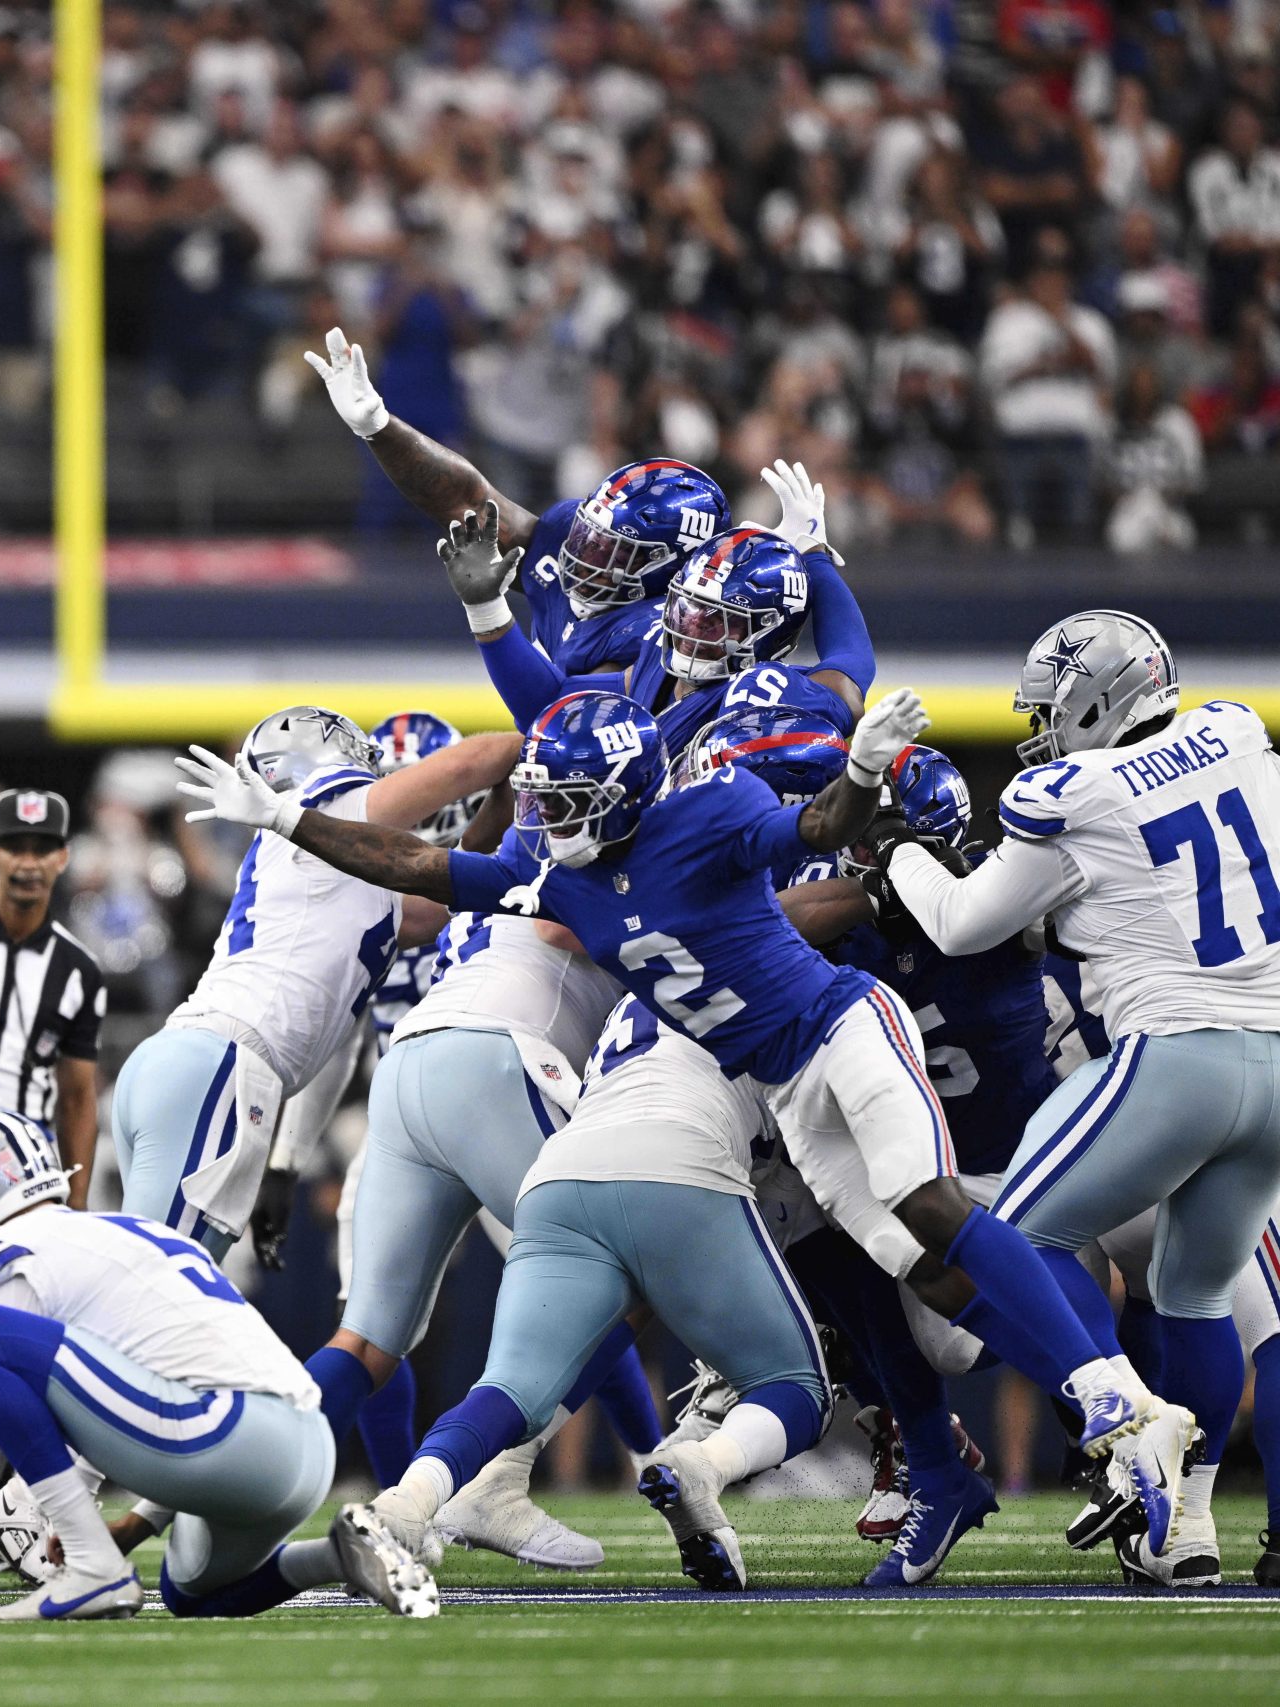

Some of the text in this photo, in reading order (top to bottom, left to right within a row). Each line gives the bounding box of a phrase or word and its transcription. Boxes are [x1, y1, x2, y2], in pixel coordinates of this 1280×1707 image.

[535, 555, 559, 582] C
[1017, 760, 1083, 800] 71
[1112, 726, 1230, 798] THOMAS
[1138, 786, 1280, 968] 71
[618, 930, 748, 1040] 2
[92, 1215, 246, 1306] 5
